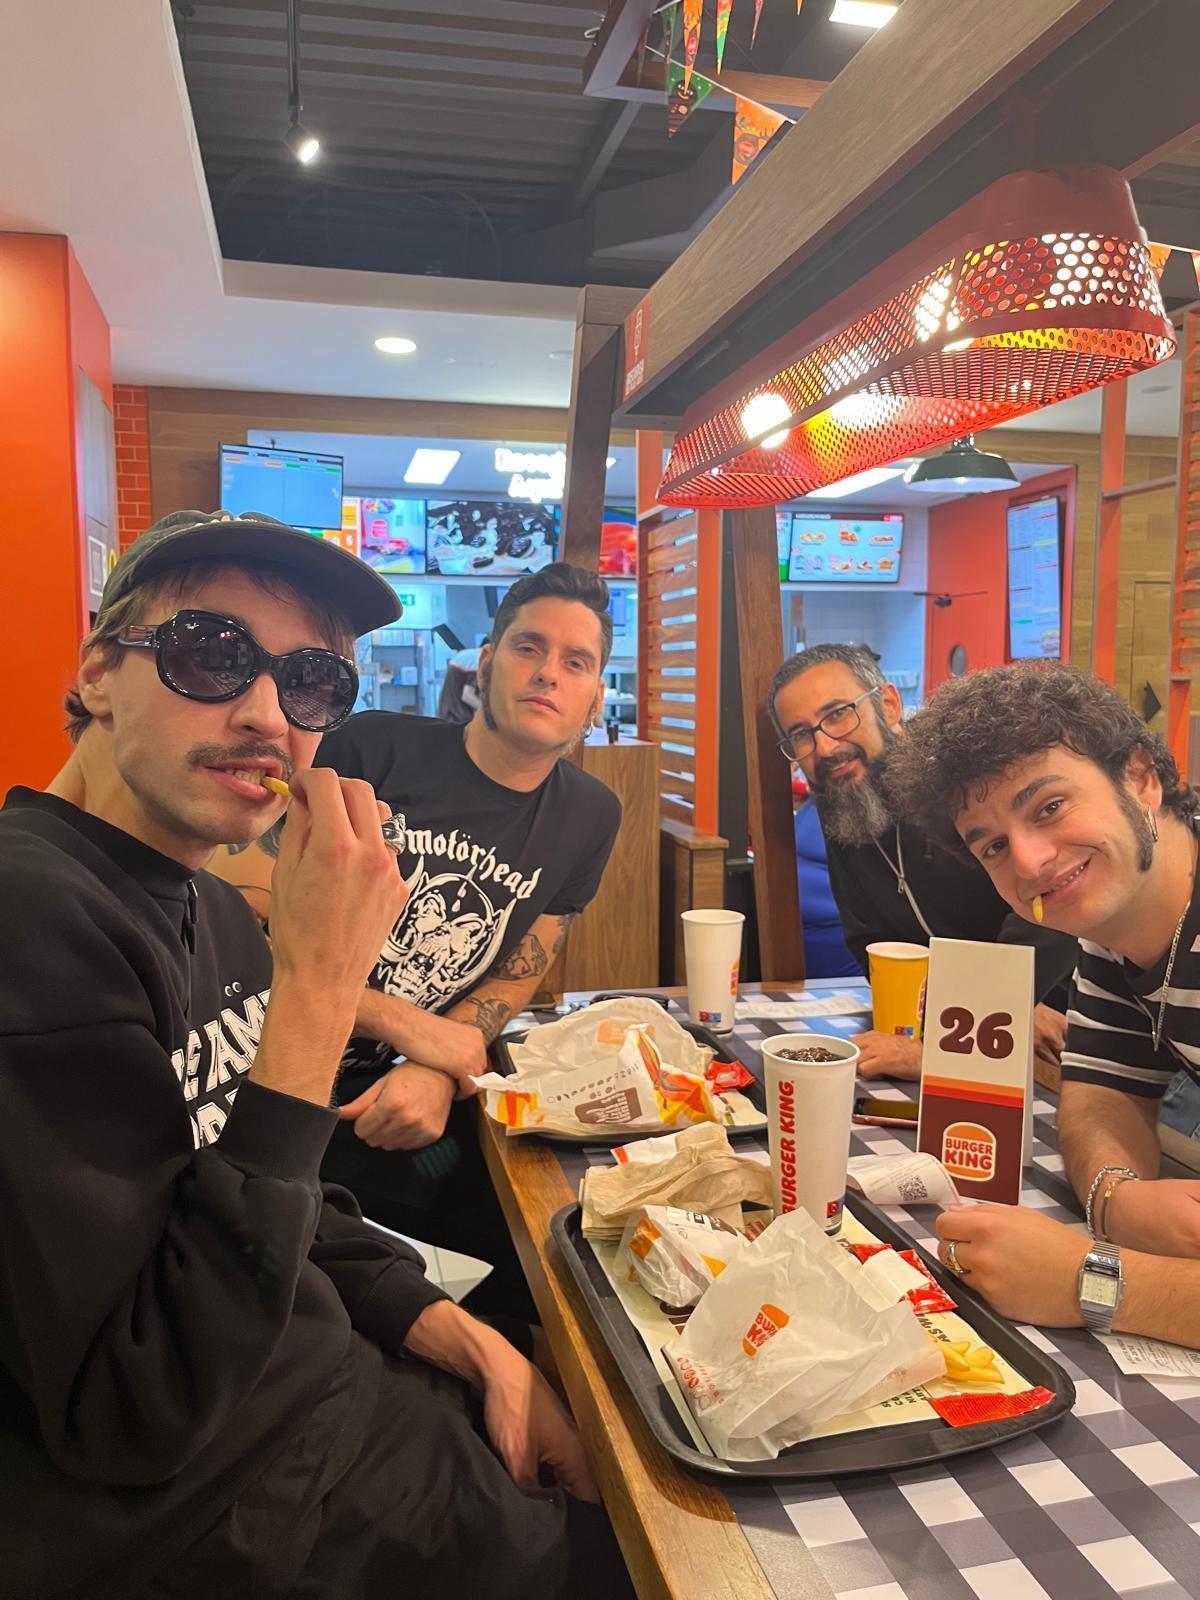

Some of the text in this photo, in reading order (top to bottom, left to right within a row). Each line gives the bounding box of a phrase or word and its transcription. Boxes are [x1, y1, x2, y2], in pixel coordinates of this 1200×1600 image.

[938, 1006, 1015, 1060] 26
[944, 1149, 993, 1170] KING
[945, 1138, 993, 1155] BURGER
[780, 1138, 798, 1216] BURGER
